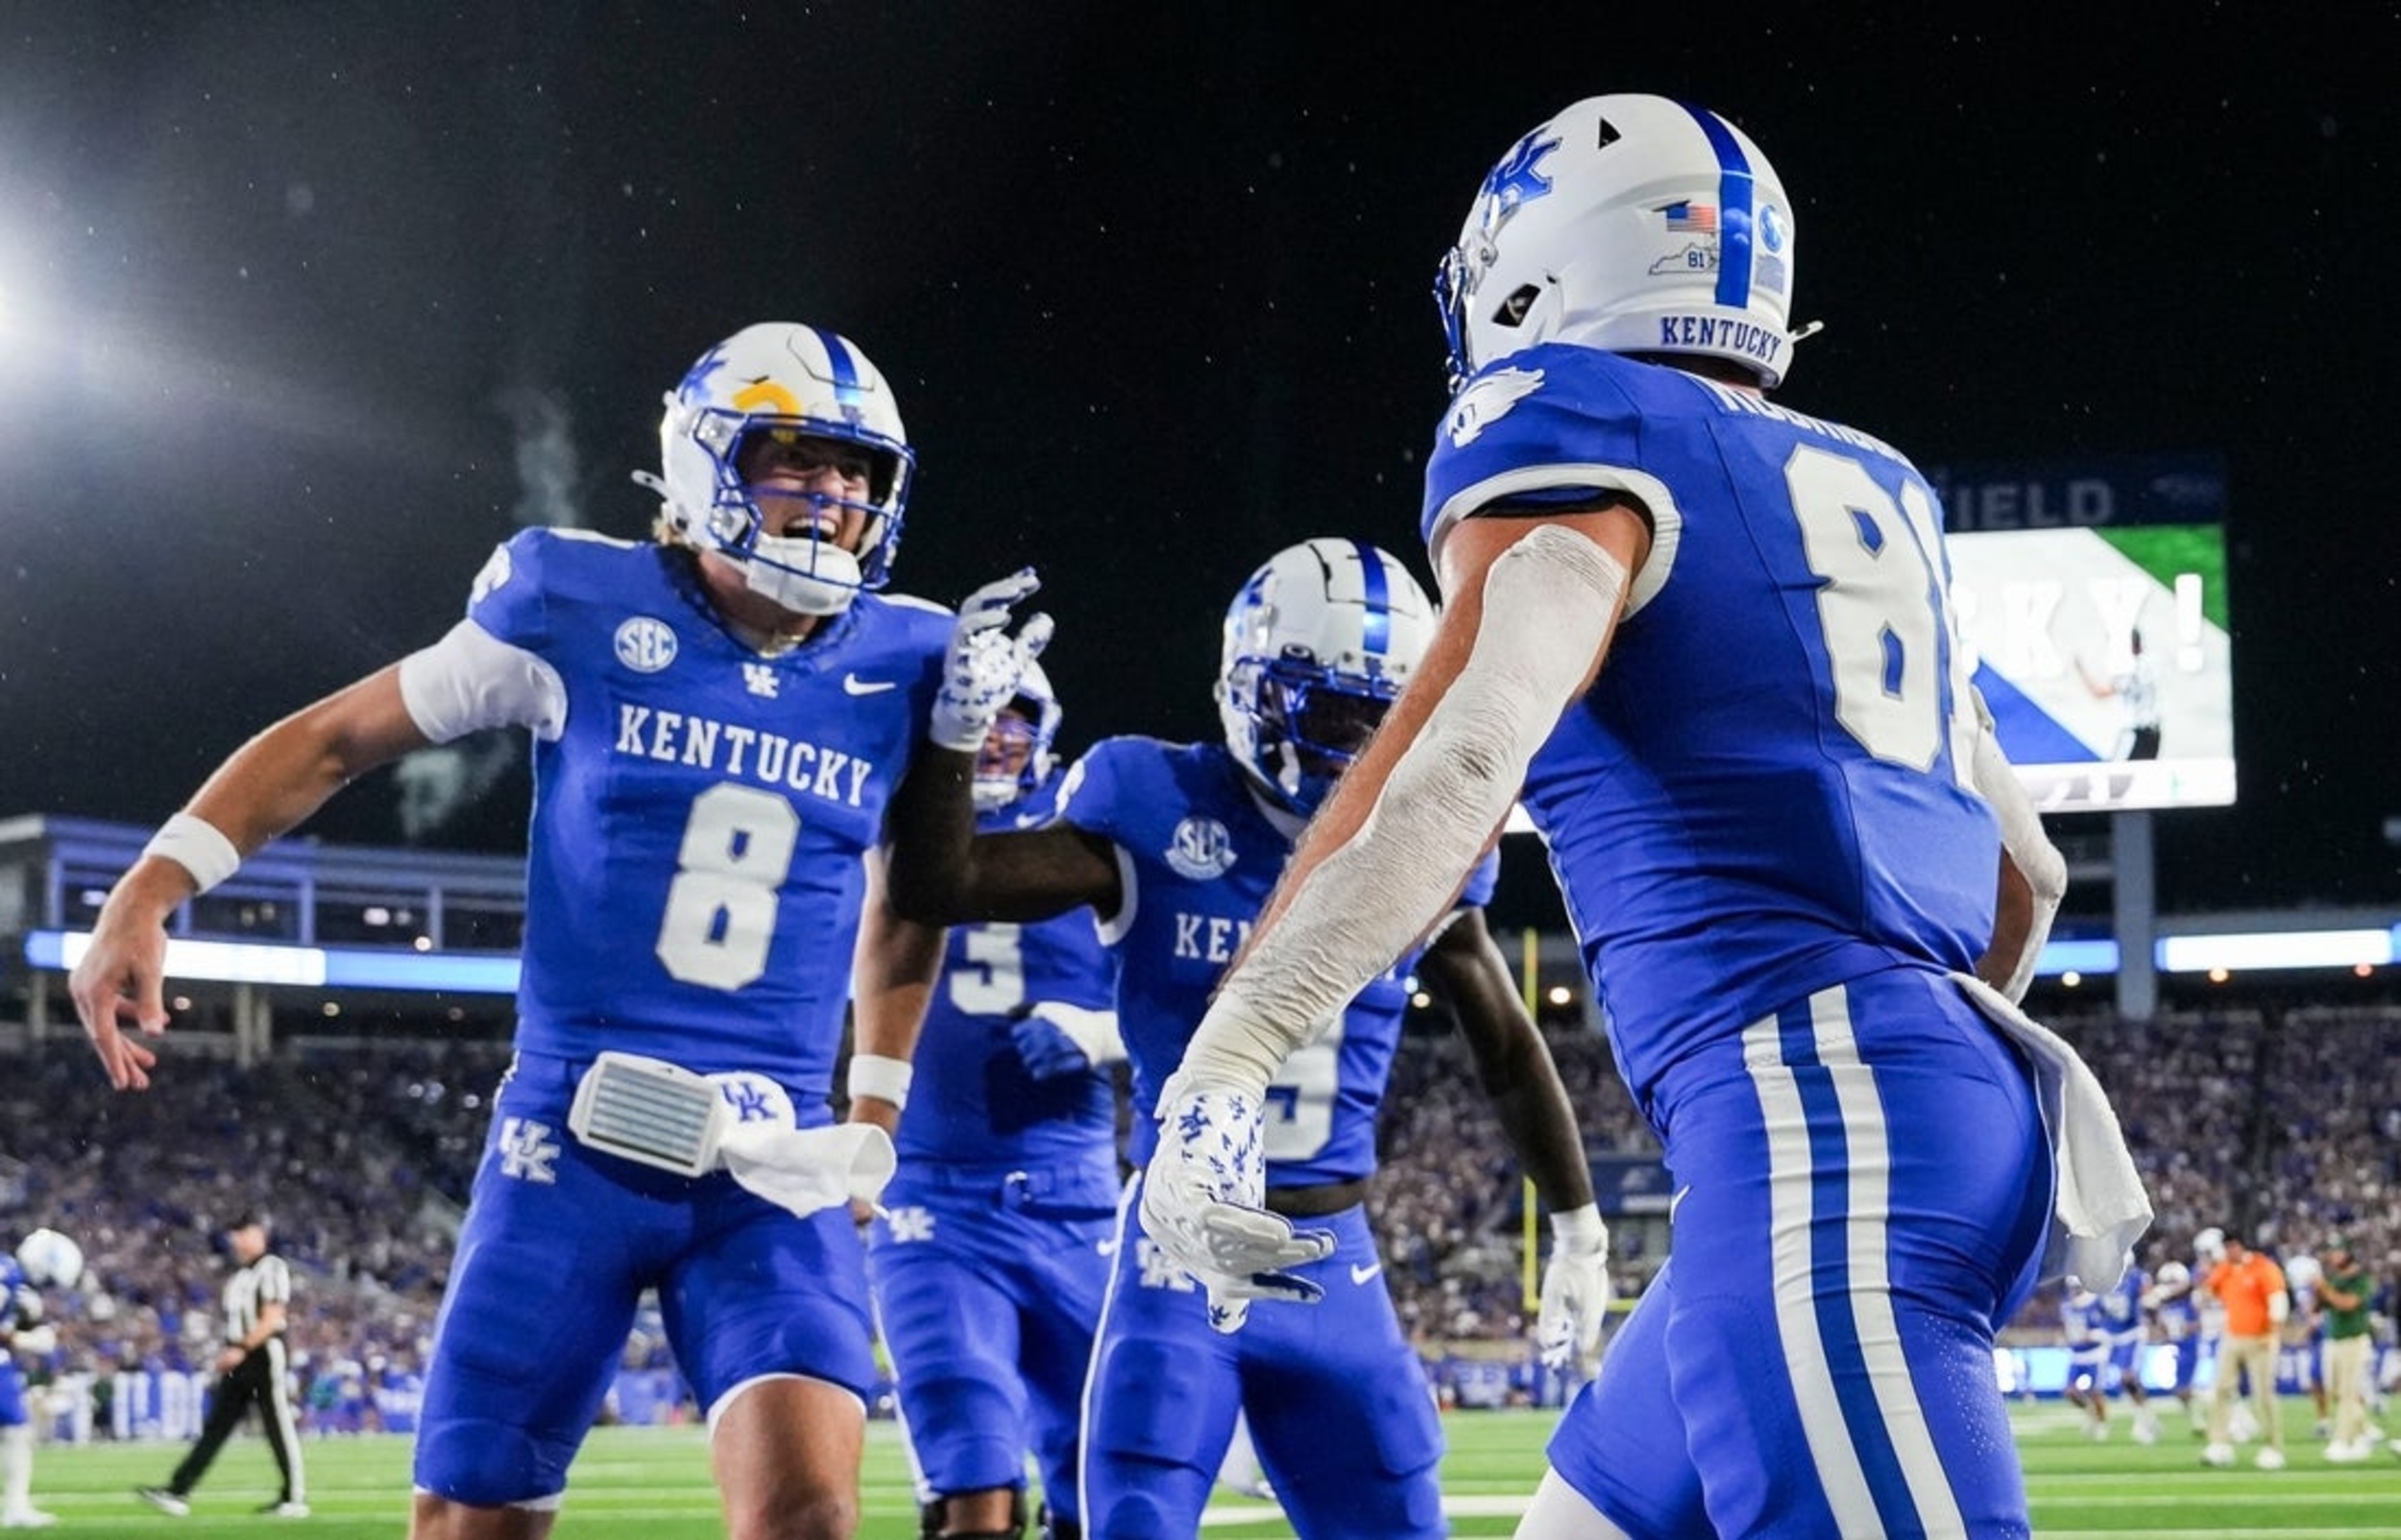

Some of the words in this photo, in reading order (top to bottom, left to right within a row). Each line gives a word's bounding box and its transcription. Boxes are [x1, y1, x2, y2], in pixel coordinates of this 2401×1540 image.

[1687, 250, 1706, 270] 81
[1661, 315, 1783, 363] KENTUCKY
[1953, 477, 2113, 528] IELD
[617, 618, 676, 669] SEC
[615, 703, 873, 808] KENTUCKY
[655, 781, 801, 992] 8
[720, 1080, 779, 1123] UK
[499, 1117, 561, 1185] UK
